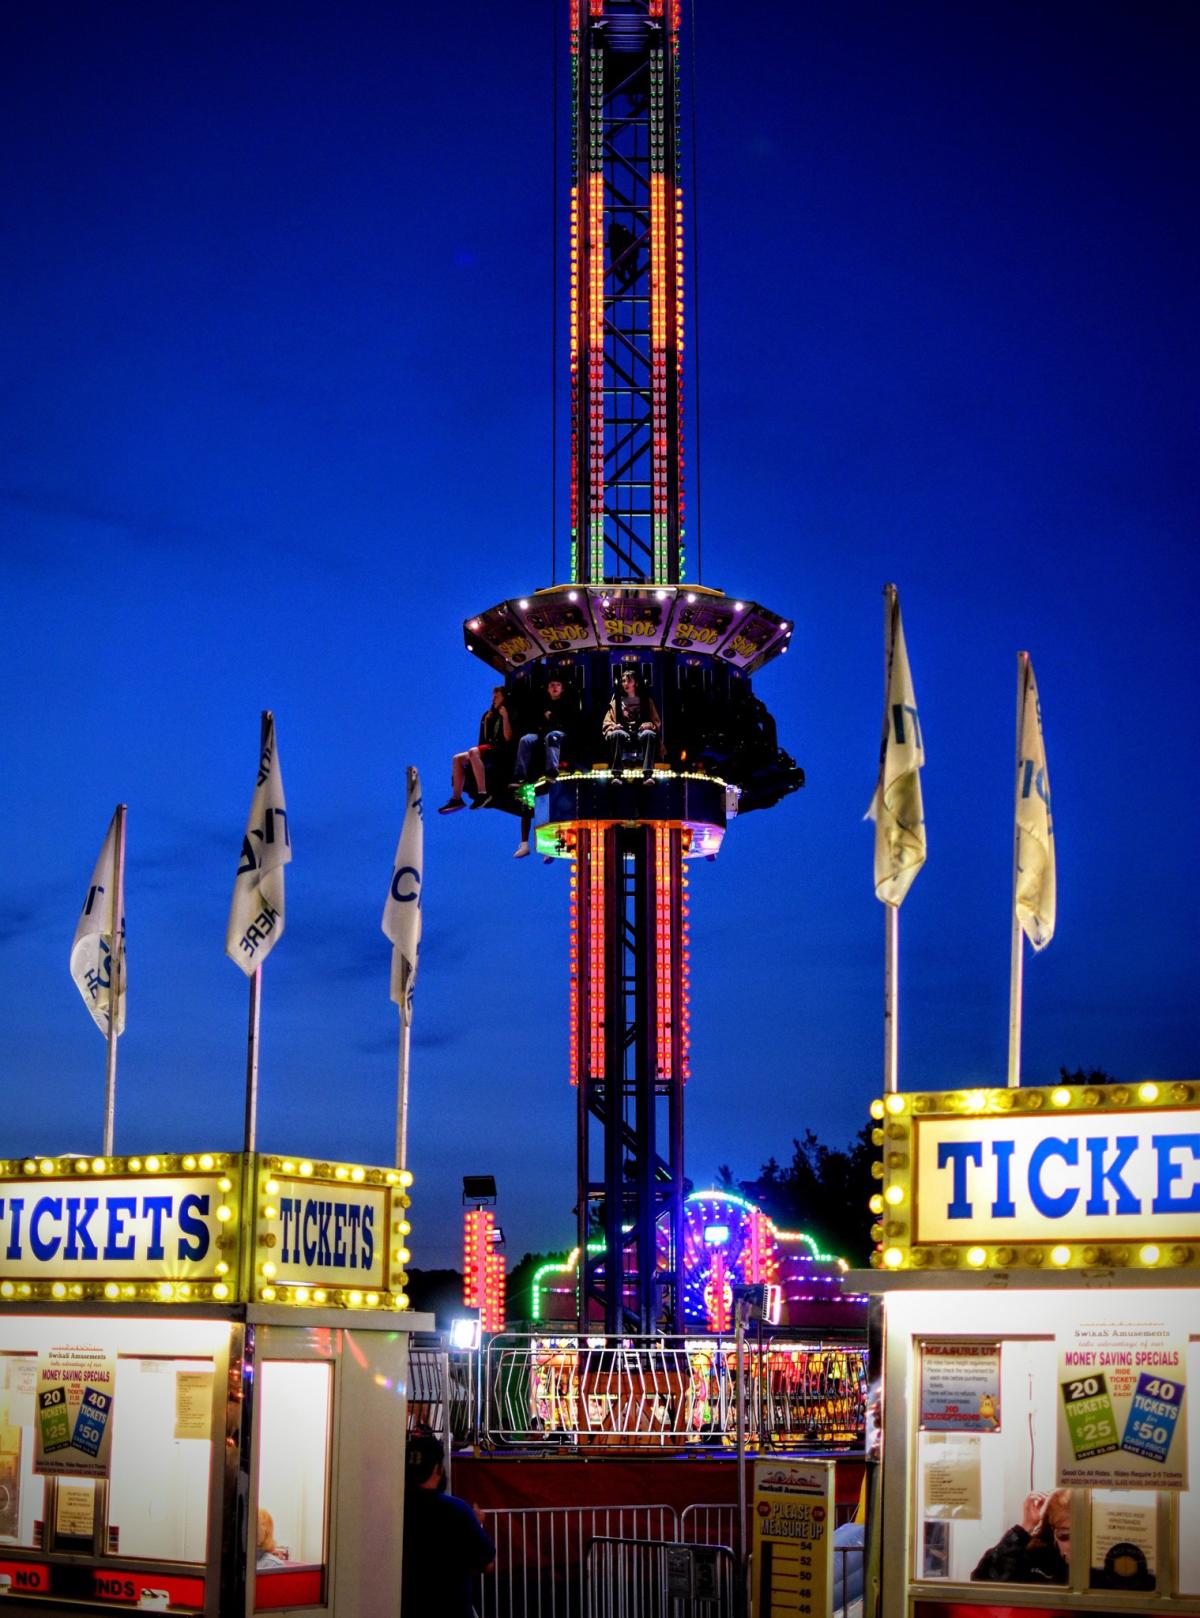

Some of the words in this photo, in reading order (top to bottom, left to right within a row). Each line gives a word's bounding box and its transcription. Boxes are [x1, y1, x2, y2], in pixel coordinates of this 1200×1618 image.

[0, 1194, 210, 1262] ICKETS
[280, 1197, 375, 1270] TICKETS
[1112, 1329, 1171, 1338] Amusements
[925, 1346, 979, 1356] MEASURE
[981, 1346, 997, 1356] UP
[1065, 1351, 1097, 1366] MONEY
[1099, 1351, 1133, 1366] SAVING
[1135, 1351, 1180, 1366] SPECIALS
[42, 1369, 62, 1382] MONEY
[62, 1370, 82, 1382] SAVING
[83, 1371, 110, 1382] SPECIALS
[1069, 1378, 1099, 1399] 20
[1145, 1379, 1176, 1400] 40
[44, 1391, 61, 1406] 20
[88, 1393, 106, 1409] 40
[41, 1404, 66, 1419] TICKETS
[81, 1405, 107, 1424] TICKETS
[945, 1405, 959, 1413] NO
[1066, 1397, 1110, 1417] TICKETS
[1134, 1396, 1178, 1420] TICKETS
[79, 1424, 99, 1443] $50
[1076, 1421, 1112, 1441] $25
[1132, 1421, 1168, 1445] $50
[1077, 1450, 1096, 1459] SAVE
[1122, 1443, 1140, 1454] SAVE
[773, 1503, 811, 1521] PLEASE
[760, 1519, 809, 1538] MEASURE
[811, 1523, 824, 1540] UP
[800, 1541, 812, 1550] 54
[799, 1557, 812, 1566] 52
[16, 1571, 41, 1587] NO
[799, 1572, 812, 1581] 50
